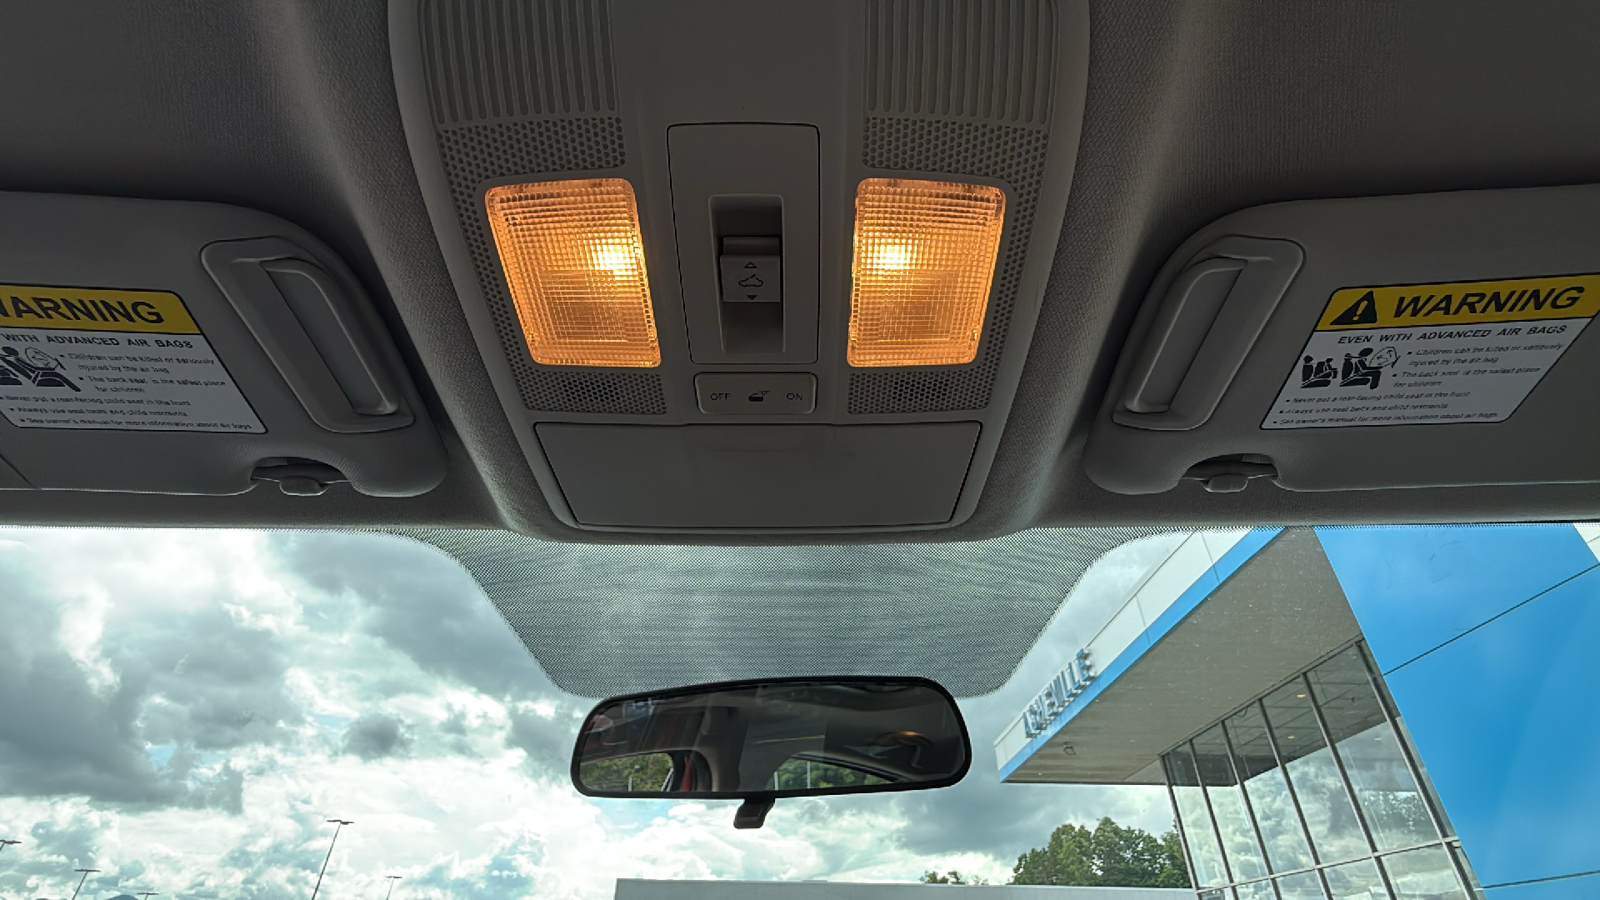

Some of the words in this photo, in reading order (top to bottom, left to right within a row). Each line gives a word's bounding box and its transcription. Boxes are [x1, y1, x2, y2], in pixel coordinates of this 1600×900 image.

[1393, 286, 1585, 318] WARNING
[1, 333, 40, 342] WITH
[46, 335, 120, 346] ADVANCED
[127, 338, 151, 347] AIR
[155, 339, 193, 349] BAGS
[1338, 335, 1372, 344] EVEN
[1379, 333, 1412, 342] WITH
[1416, 329, 1492, 340] ADVANCED
[1497, 327, 1522, 336] AIR
[1526, 325, 1568, 335] BAGS
[710, 393, 731, 401] OFF
[786, 393, 803, 401] ON
[1023, 648, 1095, 738] ASHEVILLE
